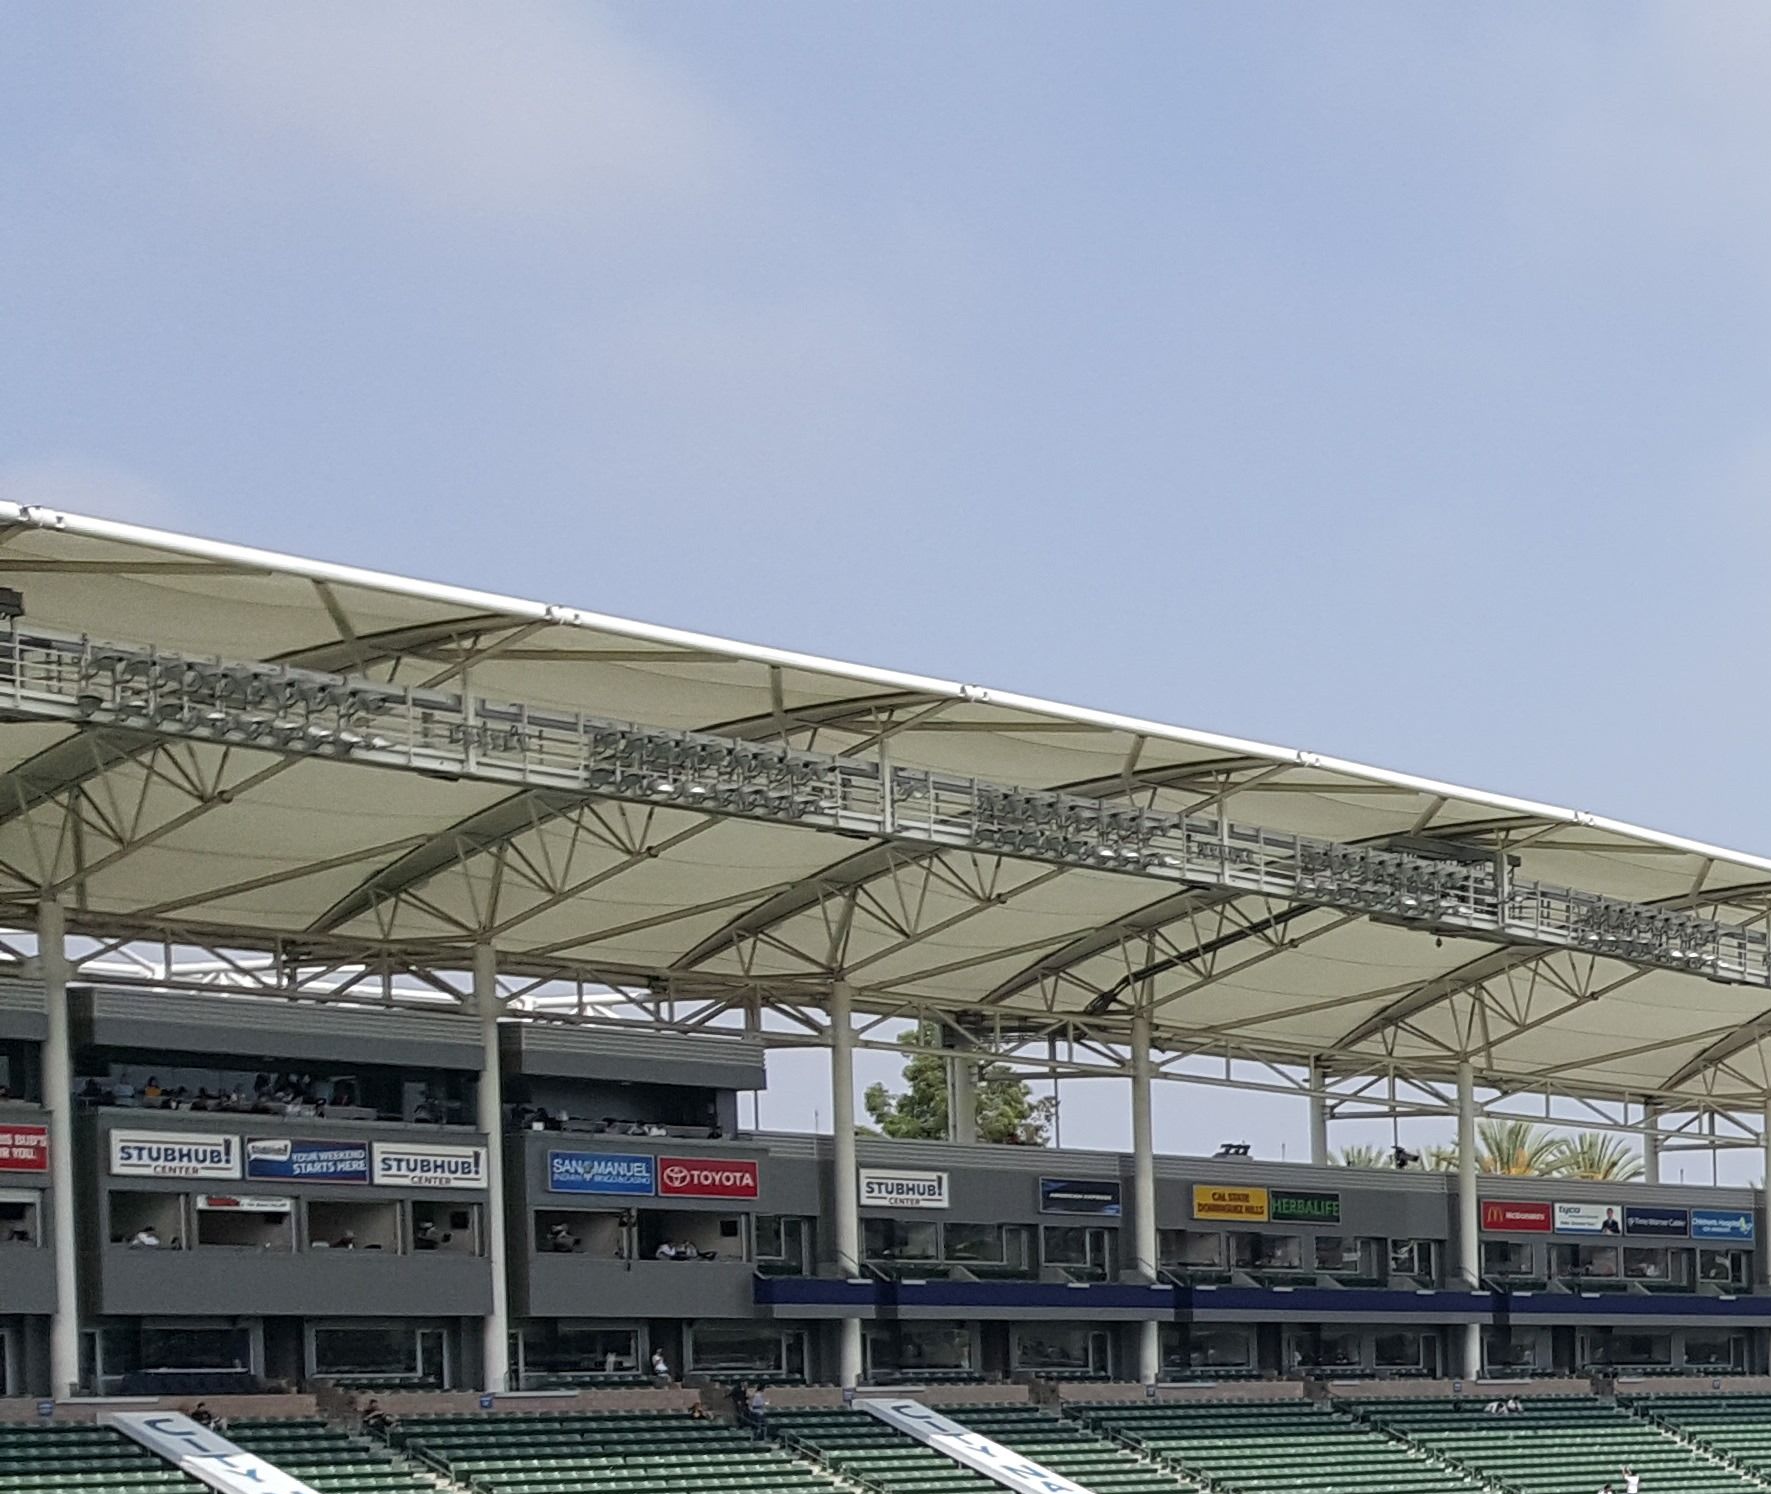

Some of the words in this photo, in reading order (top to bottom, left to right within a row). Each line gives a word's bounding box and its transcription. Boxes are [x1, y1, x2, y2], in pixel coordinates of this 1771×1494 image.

[120, 1138, 232, 1164] STUBHUB!
[319, 1150, 365, 1161] WEEKEND
[153, 1165, 199, 1175] CENTER
[293, 1161, 335, 1174] STARTS
[336, 1160, 368, 1172] HERE
[381, 1150, 480, 1175] STUBHUB!
[553, 1159, 584, 1174] SAN
[592, 1160, 650, 1176] MANUEL
[410, 1176, 451, 1185] CENTER
[691, 1171, 754, 1187] TOYOTA
[866, 1175, 943, 1196] STUBHUB!
[888, 1197, 920, 1206] CENTER
[1271, 1199, 1340, 1216] HERBALIFE
